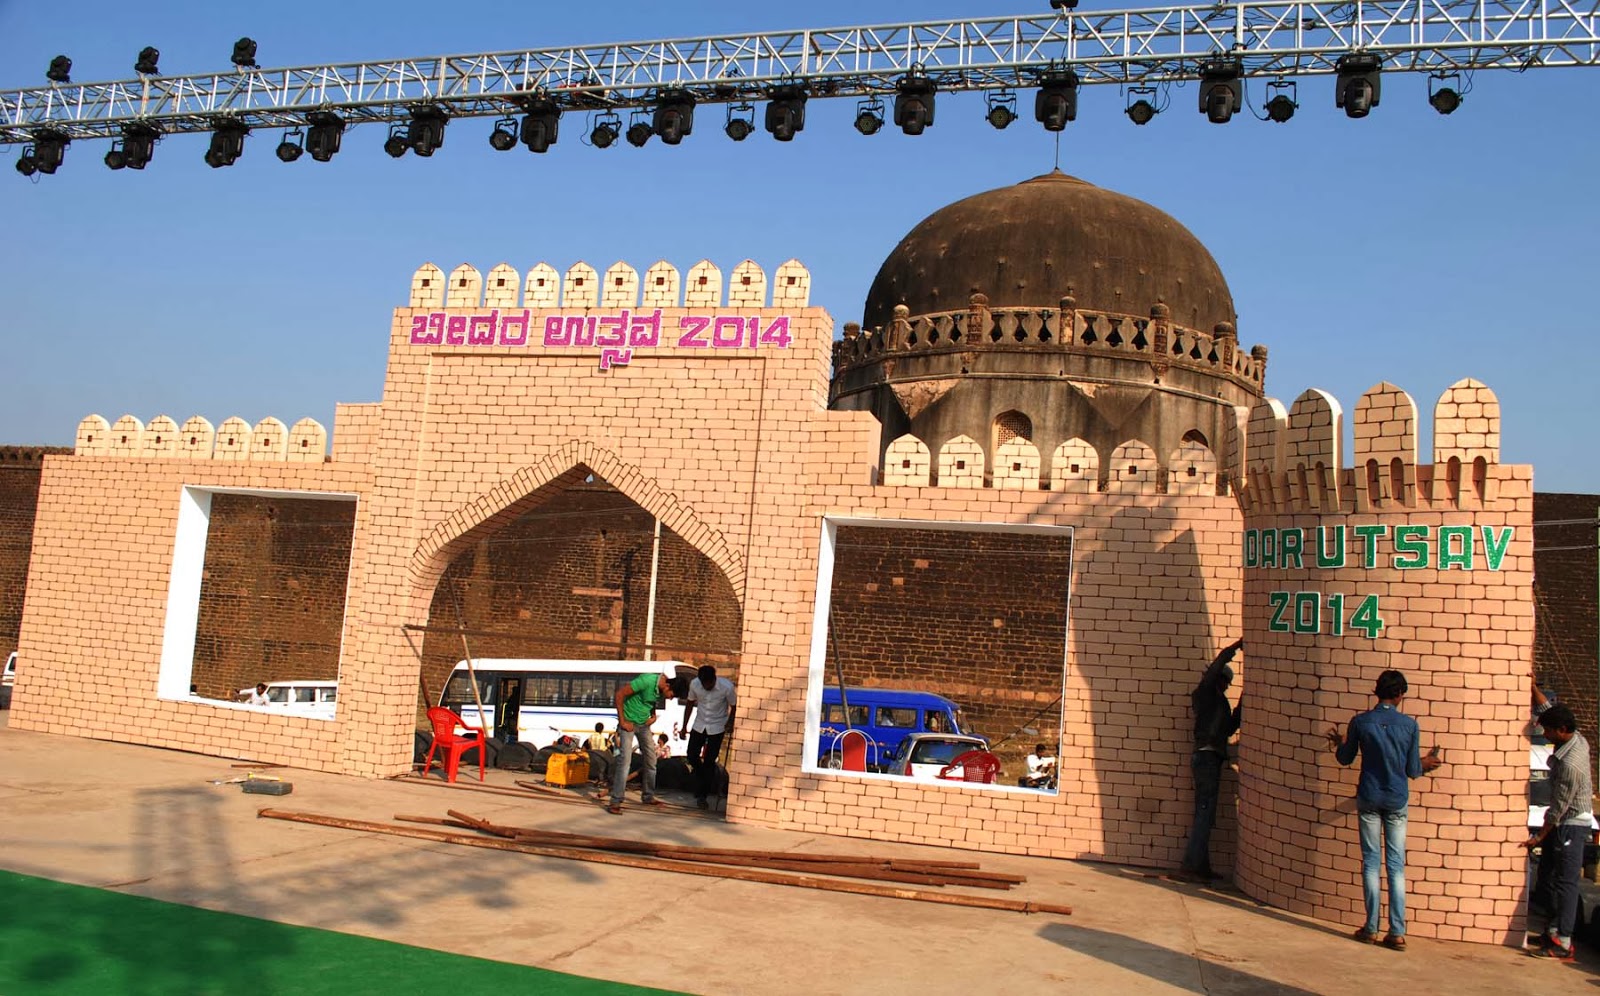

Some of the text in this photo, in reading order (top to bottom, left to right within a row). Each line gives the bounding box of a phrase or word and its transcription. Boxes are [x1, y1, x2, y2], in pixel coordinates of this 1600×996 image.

[543, 309, 662, 369] ಉತ್ಸವ
[678, 315, 792, 348] 2014
[1315, 524, 1514, 571] UTSAV
[1268, 591, 1384, 639] 2014
